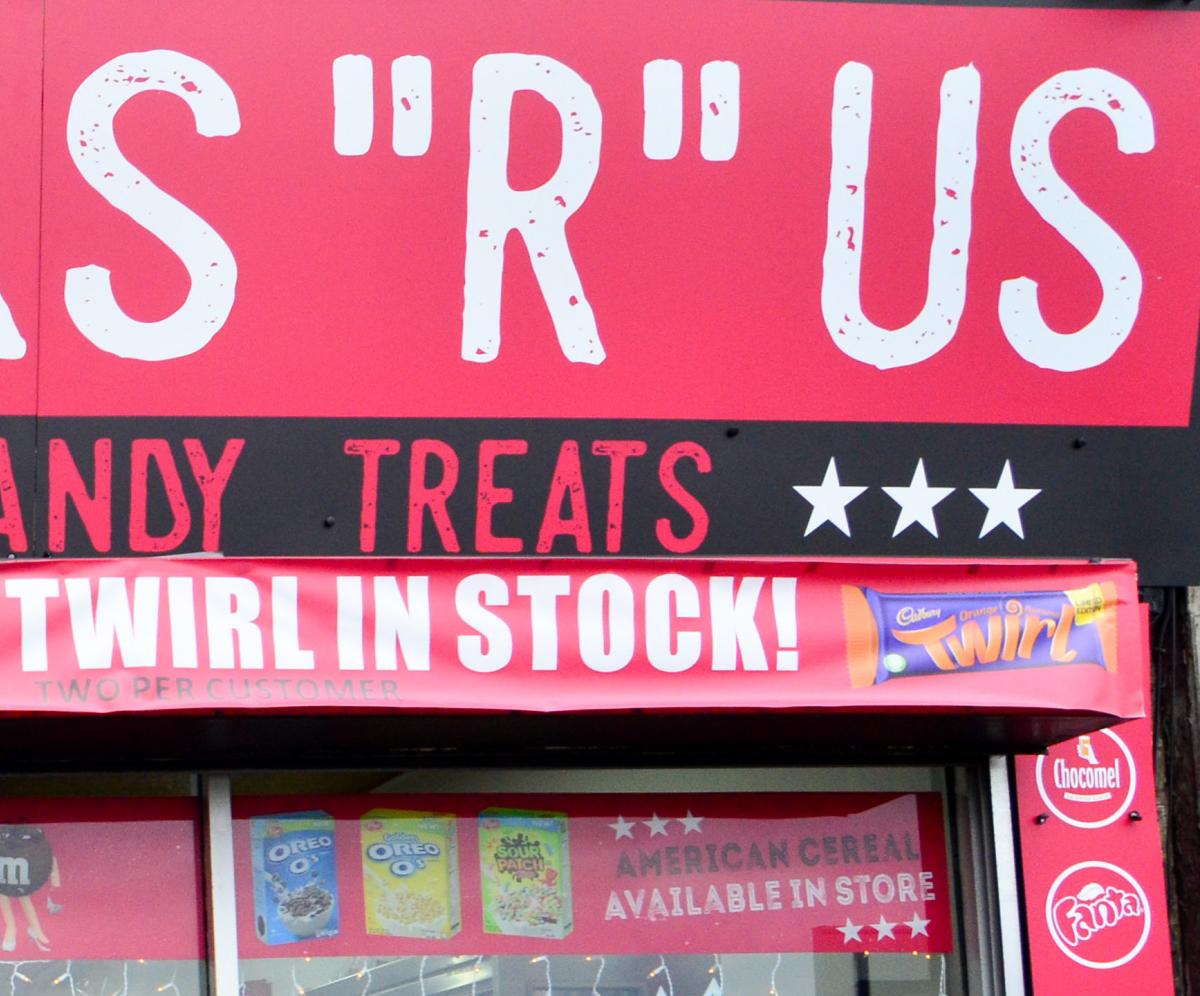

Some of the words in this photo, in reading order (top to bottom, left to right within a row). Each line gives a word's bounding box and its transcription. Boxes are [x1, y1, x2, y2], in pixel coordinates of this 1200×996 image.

[332, 53, 741, 365] "R"
[821, 62, 1156, 371] US
[344, 439, 712, 553] TREATS
[5, 576, 315, 673] TWIRL
[336, 575, 431, 672] IN
[454, 573, 799, 673] STOCK!
[890, 599, 1078, 671] Twirl
[896, 606, 942, 626] Cadbury
[35, 677, 121, 703] TWO
[132, 676, 197, 702] PER
[205, 677, 402, 702] CUSTOMER
[1053, 757, 1121, 789] Chocomel
[268, 836, 332, 863] OREO
[367, 843, 440, 862] OREO
[616, 840, 790, 879] AMERICAN
[798, 832, 920, 867] CEREAL
[604, 879, 783, 921] AVAILABLE
[790, 876, 828, 908] IN
[835, 871, 937, 906] STORE
[1053, 885, 1143, 948] Fanta
